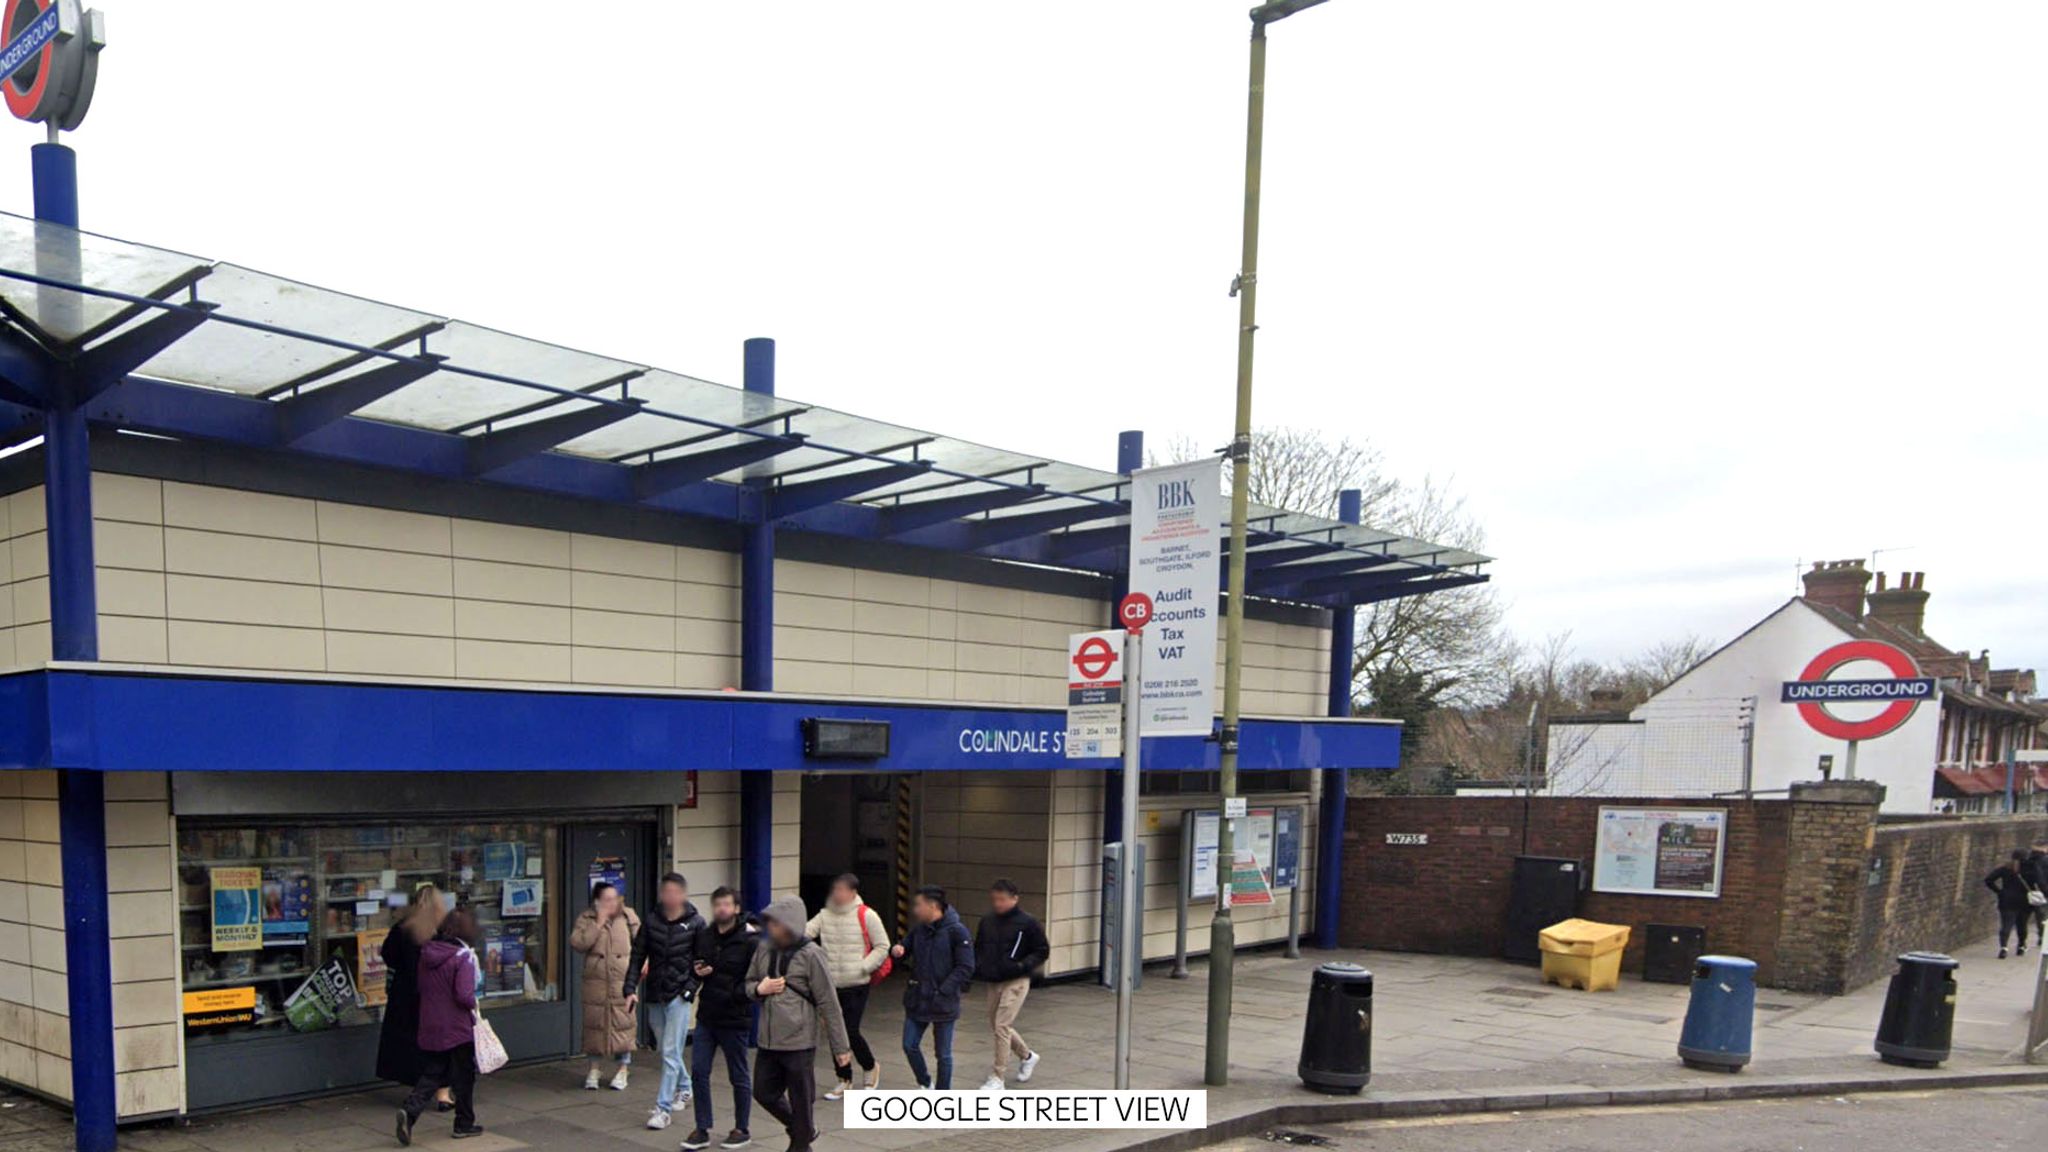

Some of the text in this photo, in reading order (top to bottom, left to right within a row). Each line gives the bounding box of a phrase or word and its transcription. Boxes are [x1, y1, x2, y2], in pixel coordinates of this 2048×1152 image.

[0, 12, 57, 77] NDERGROUND
[1158, 479, 1195, 509] BBK
[1155, 588, 1192, 603] Audit
[1123, 602, 1146, 619] CB
[1150, 607, 1206, 623] ccounts
[1161, 628, 1184, 640] Tax
[1159, 646, 1185, 660] VAT
[1788, 682, 1928, 698] UNDERGROUND
[959, 729, 1048, 753] COLINDALE
[215, 927, 250, 935] WEEKLY
[328, 960, 352, 997] TOP
